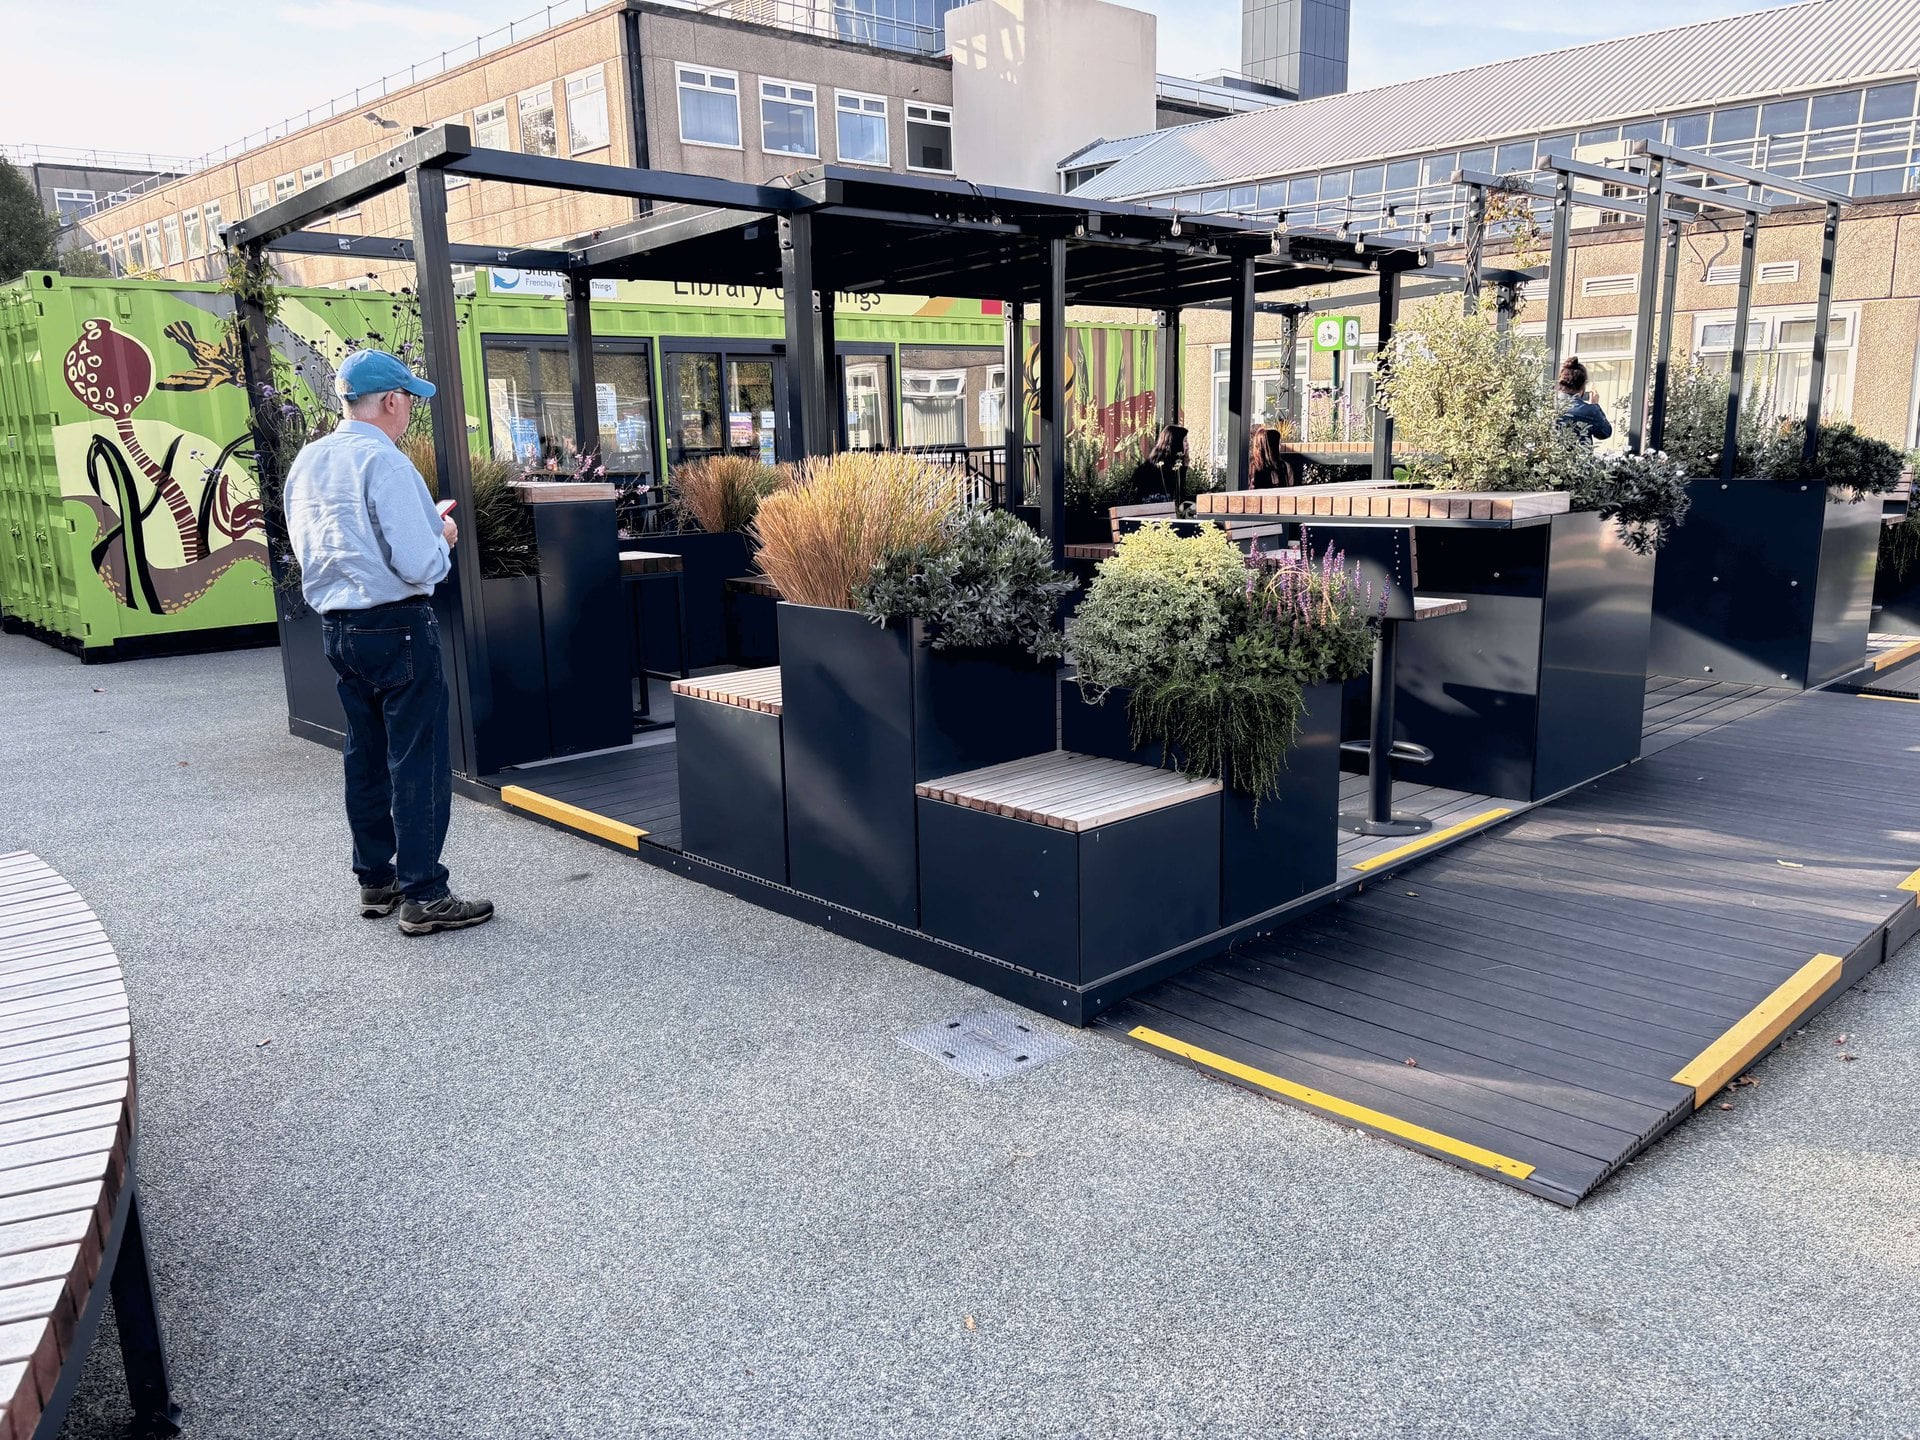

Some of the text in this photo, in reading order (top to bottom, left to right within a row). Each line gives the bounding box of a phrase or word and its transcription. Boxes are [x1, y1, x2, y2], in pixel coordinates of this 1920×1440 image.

[525, 278, 556, 288] Frenchay
[592, 281, 611, 292] Things
[675, 281, 762, 306] Library
